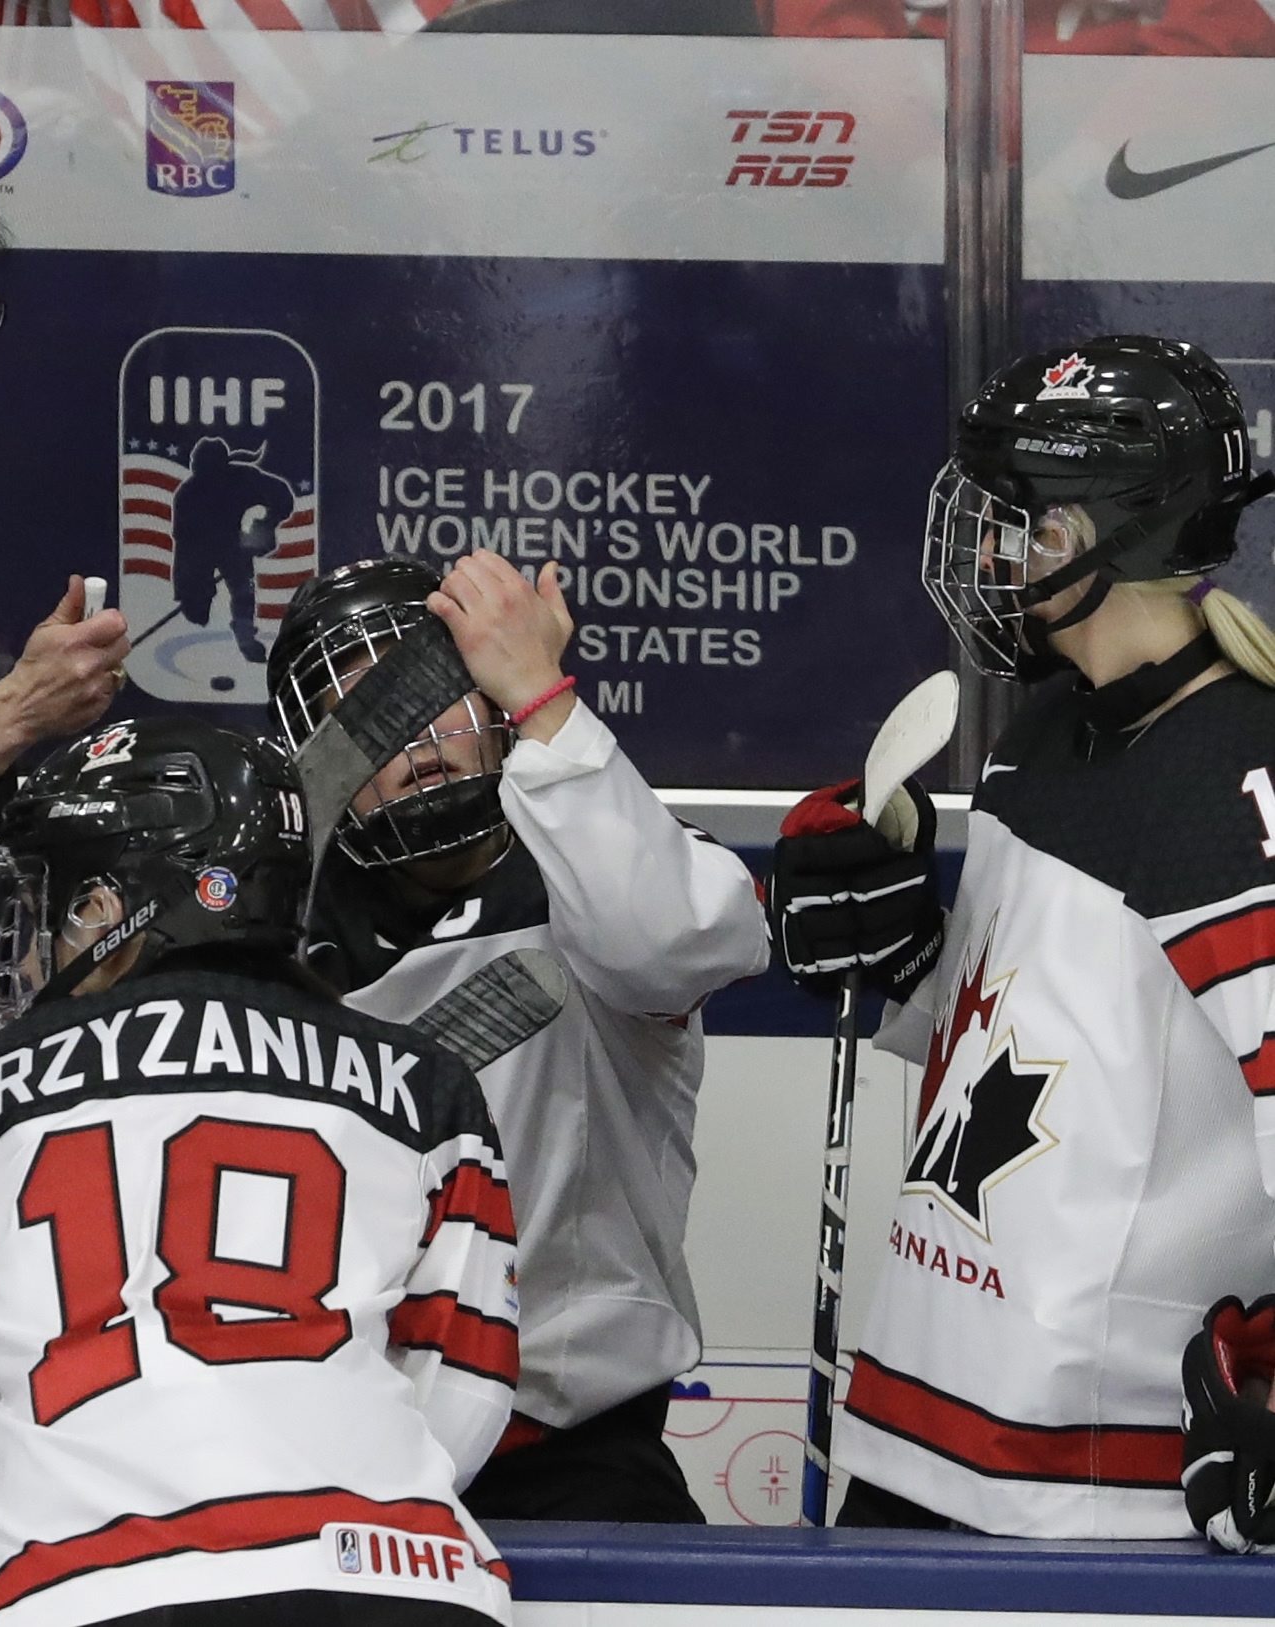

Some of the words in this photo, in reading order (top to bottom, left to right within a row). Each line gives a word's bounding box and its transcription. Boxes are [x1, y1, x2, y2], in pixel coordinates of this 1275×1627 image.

[453, 128, 596, 156] TELUS
[726, 110, 856, 143] TSN
[155, 163, 226, 190] RBC
[725, 155, 855, 187] RDS
[149, 375, 286, 426] IIHF
[379, 380, 534, 433] 2017
[379, 466, 466, 508] ICE
[482, 469, 711, 516] HOCKEY
[376, 514, 640, 560] WOMEN'S
[655, 520, 857, 567] WORLD
[579, 625, 762, 666] STATES
[597, 681, 644, 714] MI
[279, 791, 303, 832] 18
[17, 1115, 353, 1427] 18
[889, 1218, 1005, 1299] ANADA
[369, 1532, 464, 1582] IIHF
